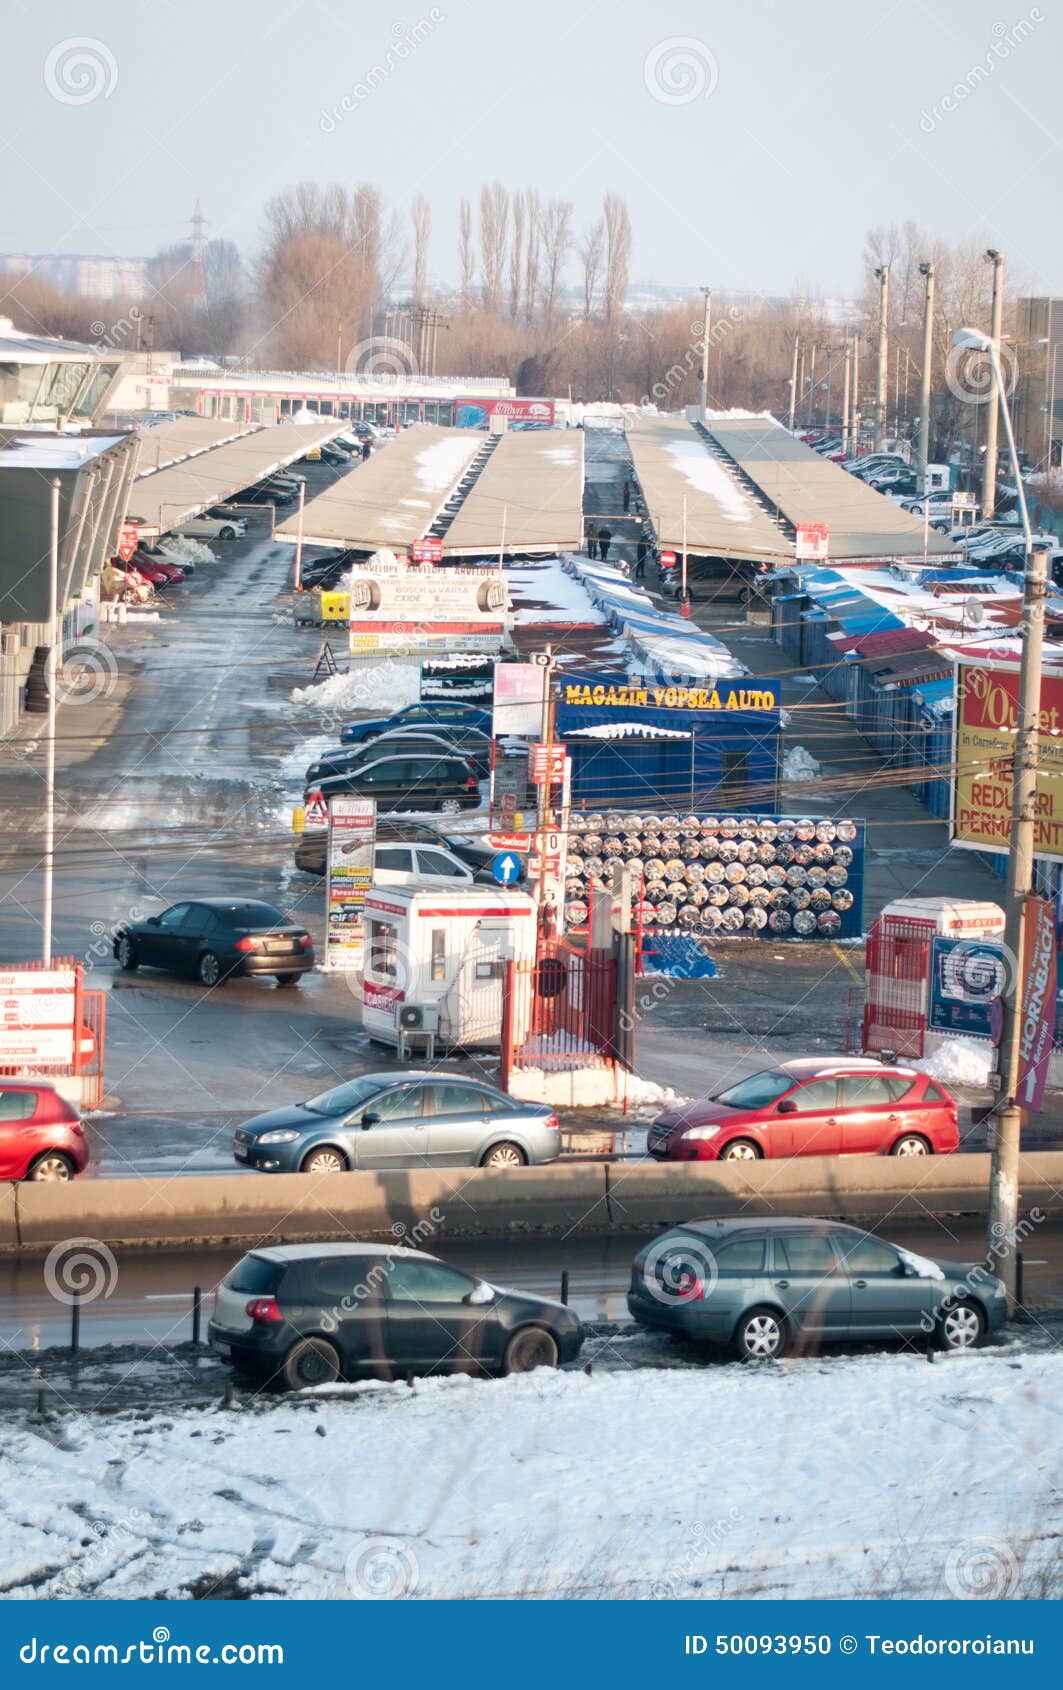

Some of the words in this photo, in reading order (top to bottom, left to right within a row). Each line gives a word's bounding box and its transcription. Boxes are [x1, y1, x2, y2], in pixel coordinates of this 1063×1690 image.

[358, 563, 398, 575] ANVELOPE
[406, 565, 447, 575] ANVELOPE
[454, 567, 496, 577] ANVELOPE
[395, 586, 426, 594] BOSCH
[439, 586, 479, 594] VARTA
[565, 684, 648, 706] MAGAZIN
[653, 687, 721, 709] VOPSEA
[726, 690, 775, 711] AUTO
[962, 733, 969, 745] in
[971, 782, 1054, 817] REDURI
[330, 913, 347, 922] elf
[1020, 914, 1054, 1062] HORNBACH
